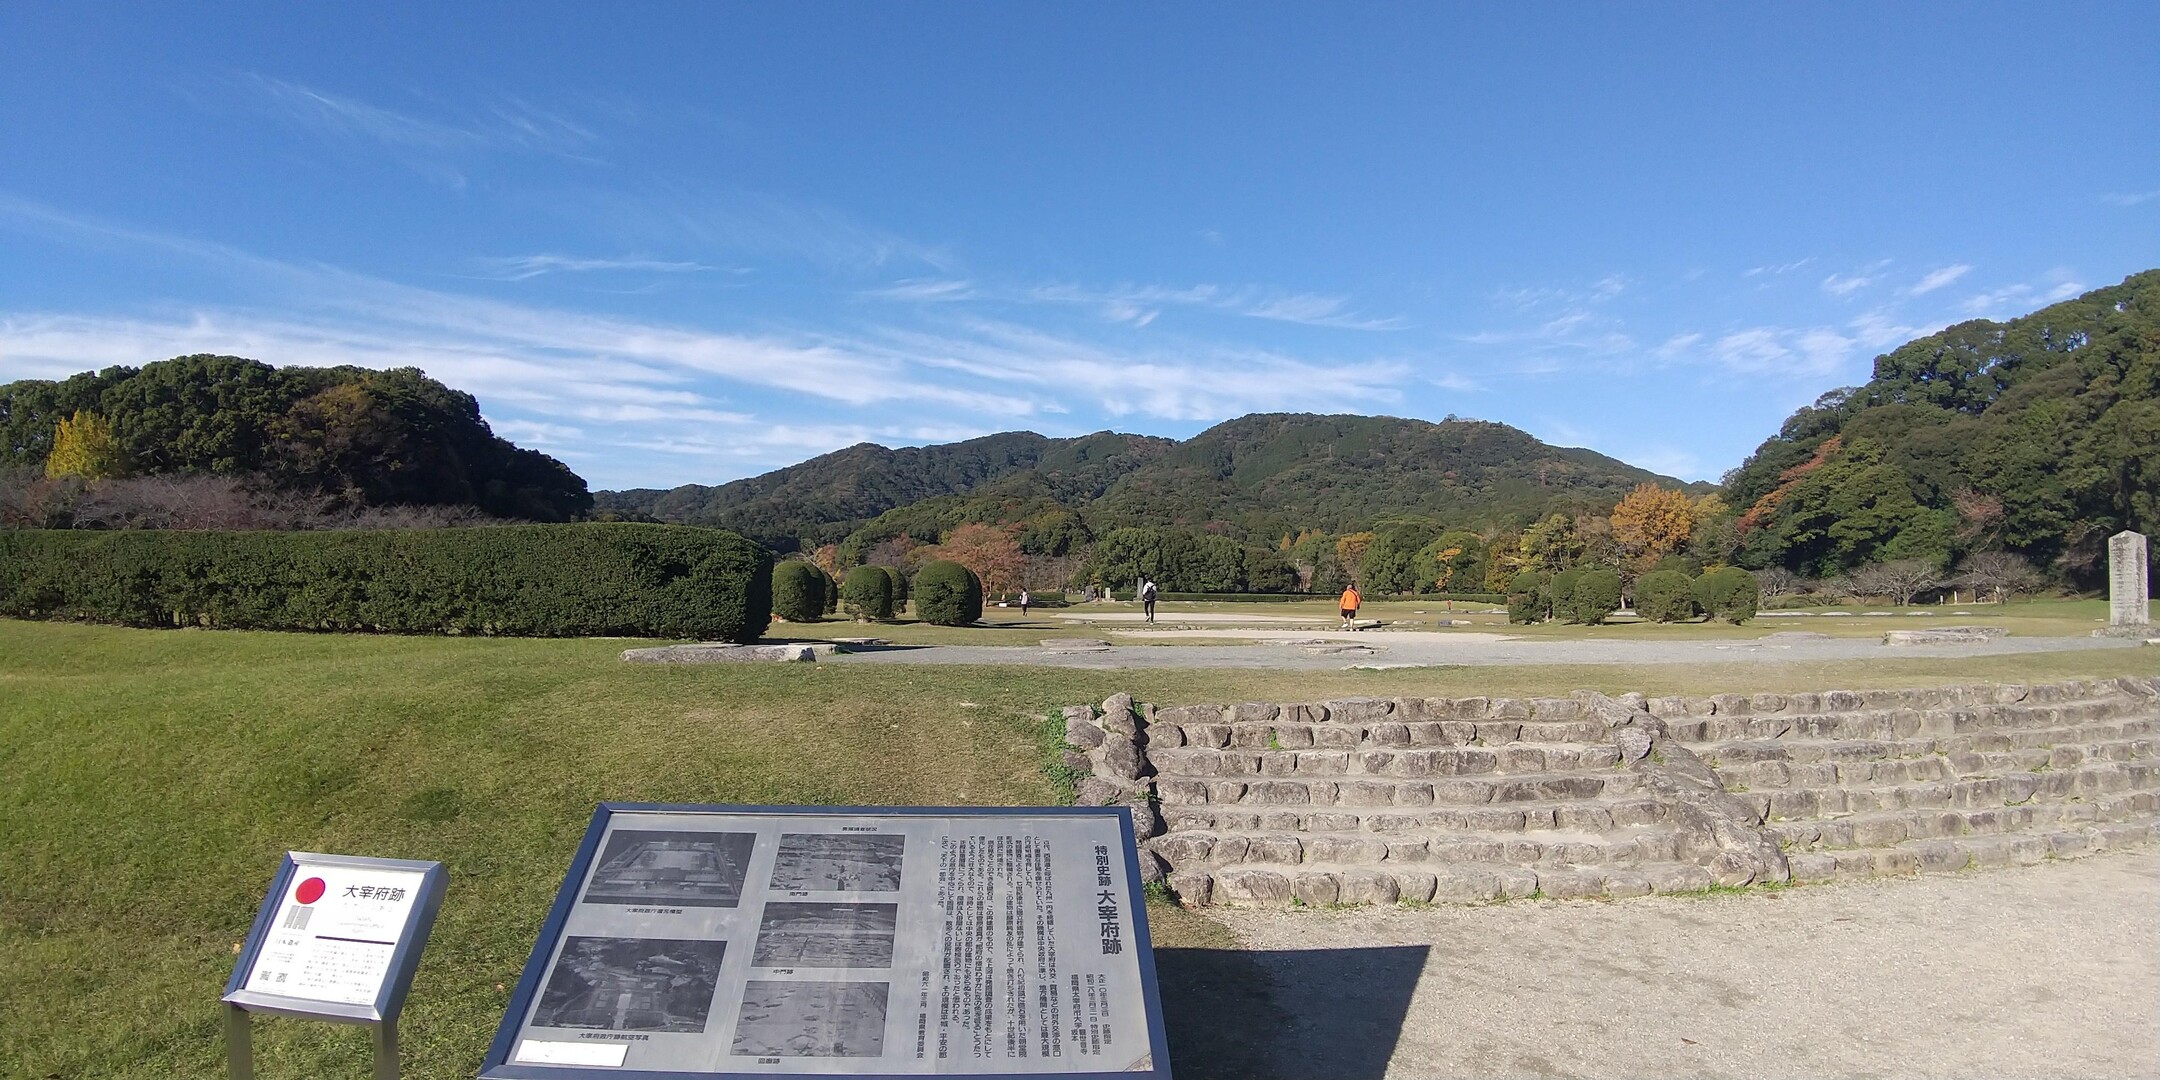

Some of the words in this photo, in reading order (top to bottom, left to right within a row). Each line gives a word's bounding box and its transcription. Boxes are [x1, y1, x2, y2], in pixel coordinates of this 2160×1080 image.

[1094, 845, 1112, 887] 特別史跡
[342, 885, 406, 902] 大宰府跡
[1097, 890, 1122, 955] 大宰府跡
